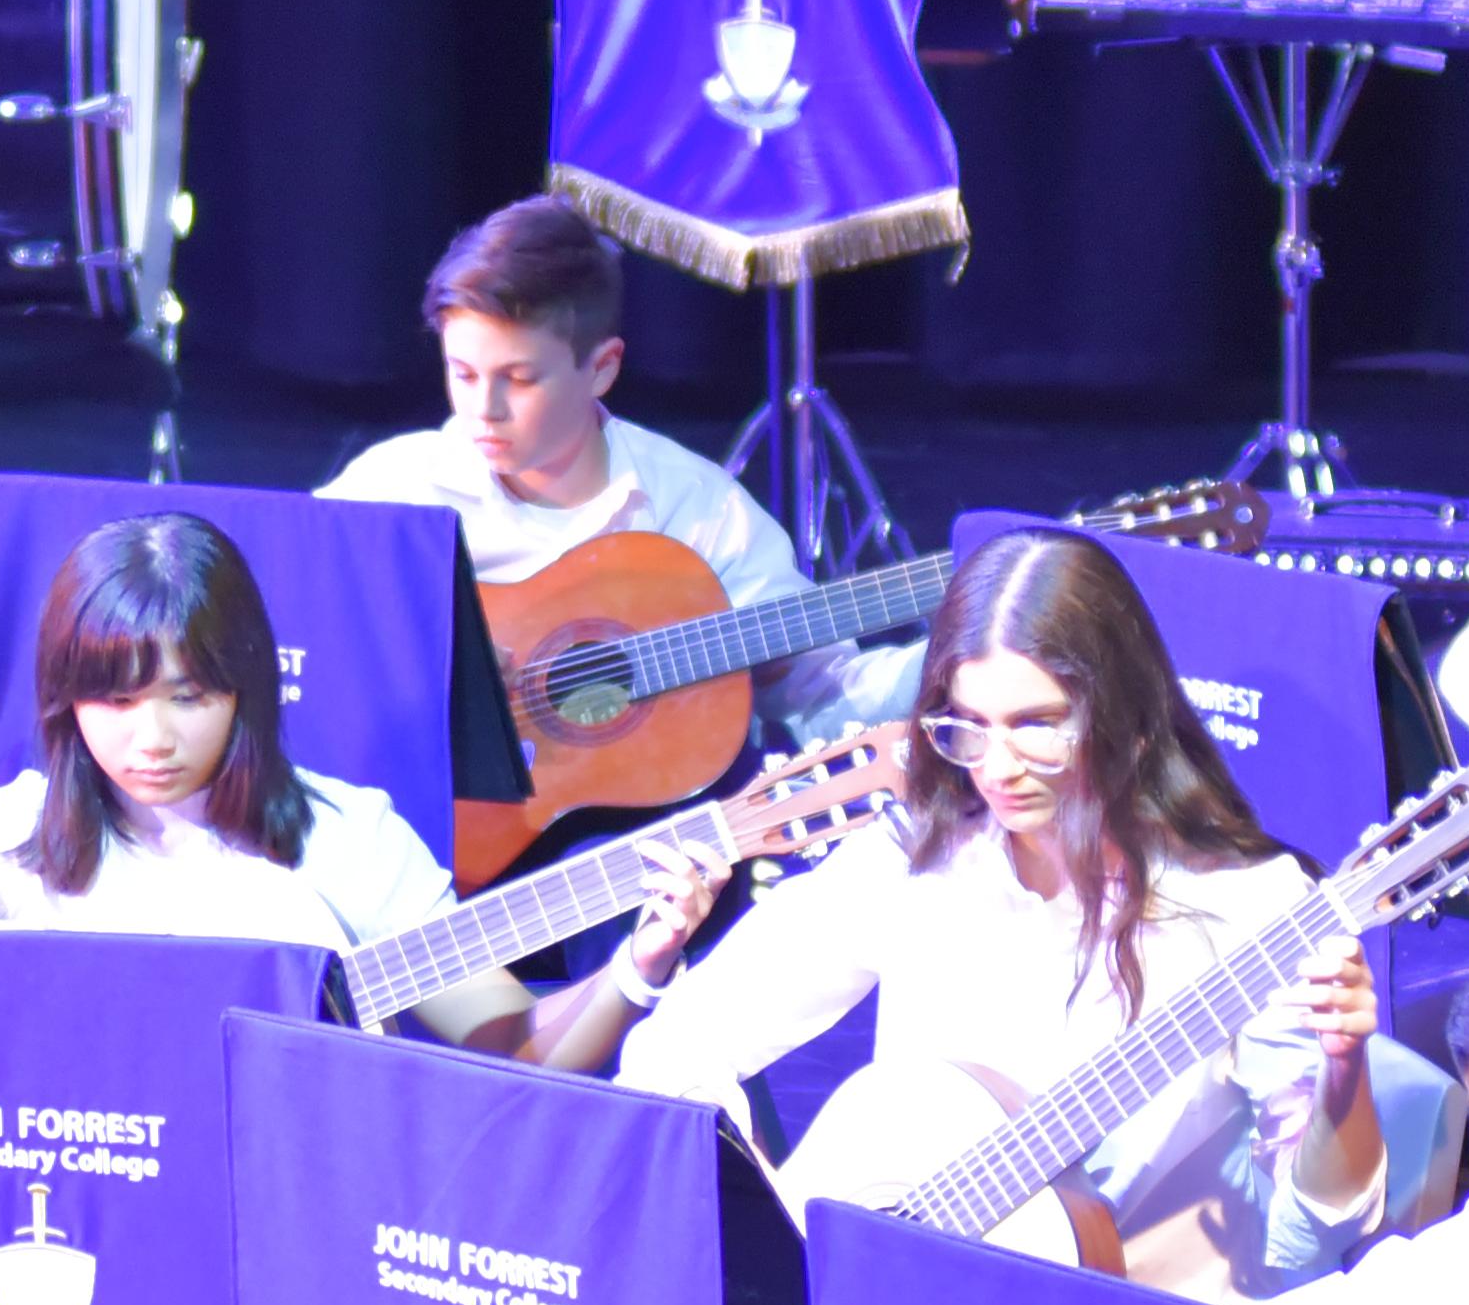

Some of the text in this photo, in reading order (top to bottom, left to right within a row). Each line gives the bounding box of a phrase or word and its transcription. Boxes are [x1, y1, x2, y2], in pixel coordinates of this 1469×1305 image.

[1207, 714, 1259, 750] llege
[17, 1106, 166, 1148] FORREST
[60, 1146, 160, 1182] College
[372, 1223, 582, 1300] JOHN FORREST
